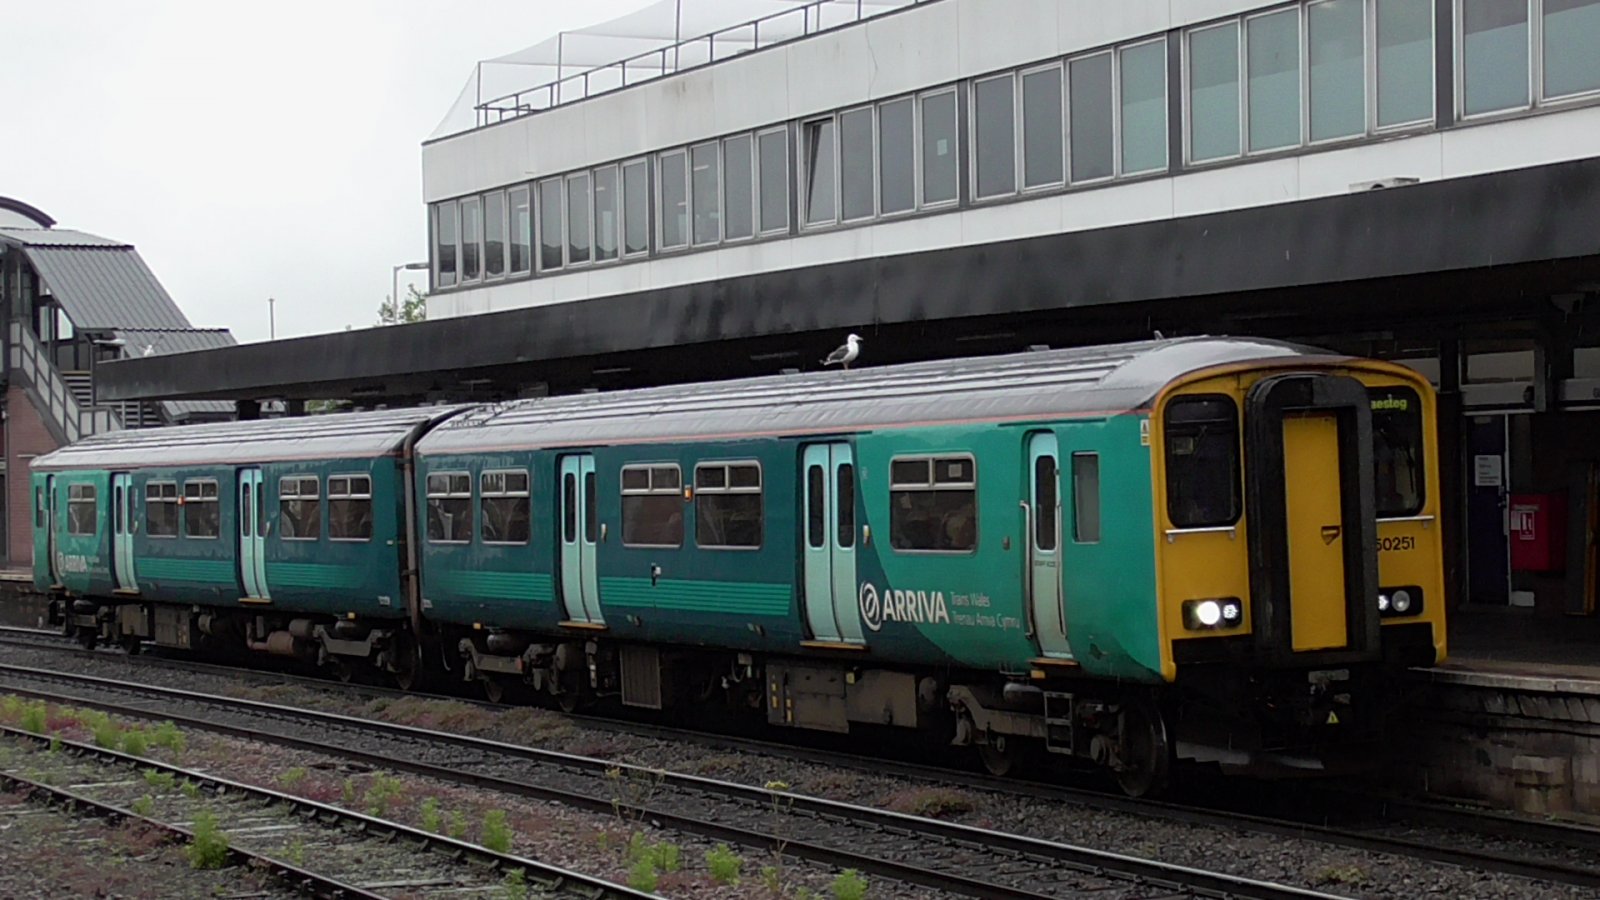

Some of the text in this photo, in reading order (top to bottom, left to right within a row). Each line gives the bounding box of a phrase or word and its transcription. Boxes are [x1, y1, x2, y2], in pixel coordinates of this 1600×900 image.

[882, 589, 950, 624] ARRIVA
[951, 592, 991, 608] Trans Wales
